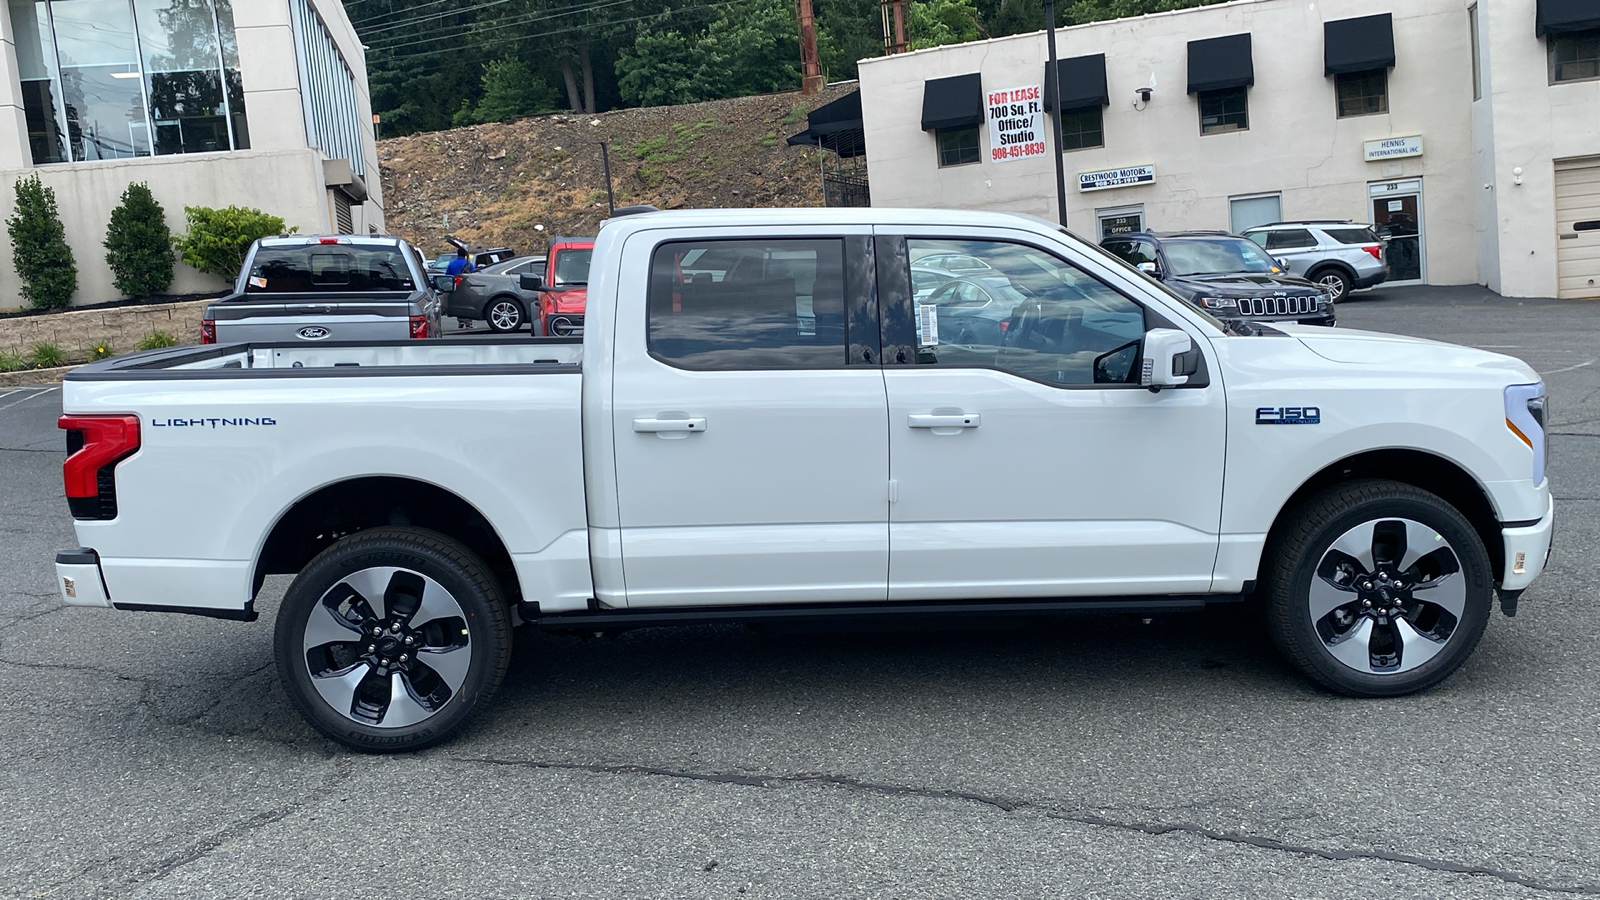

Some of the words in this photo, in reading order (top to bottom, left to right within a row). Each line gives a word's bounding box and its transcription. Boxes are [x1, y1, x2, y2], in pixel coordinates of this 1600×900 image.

[989, 92, 1007, 105] FOR
[1011, 86, 1040, 102] LEASE
[989, 105, 1008, 119] 700
[1010, 104, 1027, 116] Sq.
[1028, 101, 1041, 114] Ft.
[998, 115, 1034, 132] Office/
[1000, 130, 1035, 145] Studio
[1381, 139, 1405, 148] HENNIS
[992, 141, 1045, 160] 908-451-8839
[1368, 147, 1408, 157] INTERNATIONAL
[1080, 171, 1118, 183] CRESTWOOD
[1119, 167, 1146, 178] MOTORS
[1111, 226, 1132, 234] OFFICE
[1255, 407, 1320, 419] F-150
[152, 417, 277, 429] LIGHTNING
